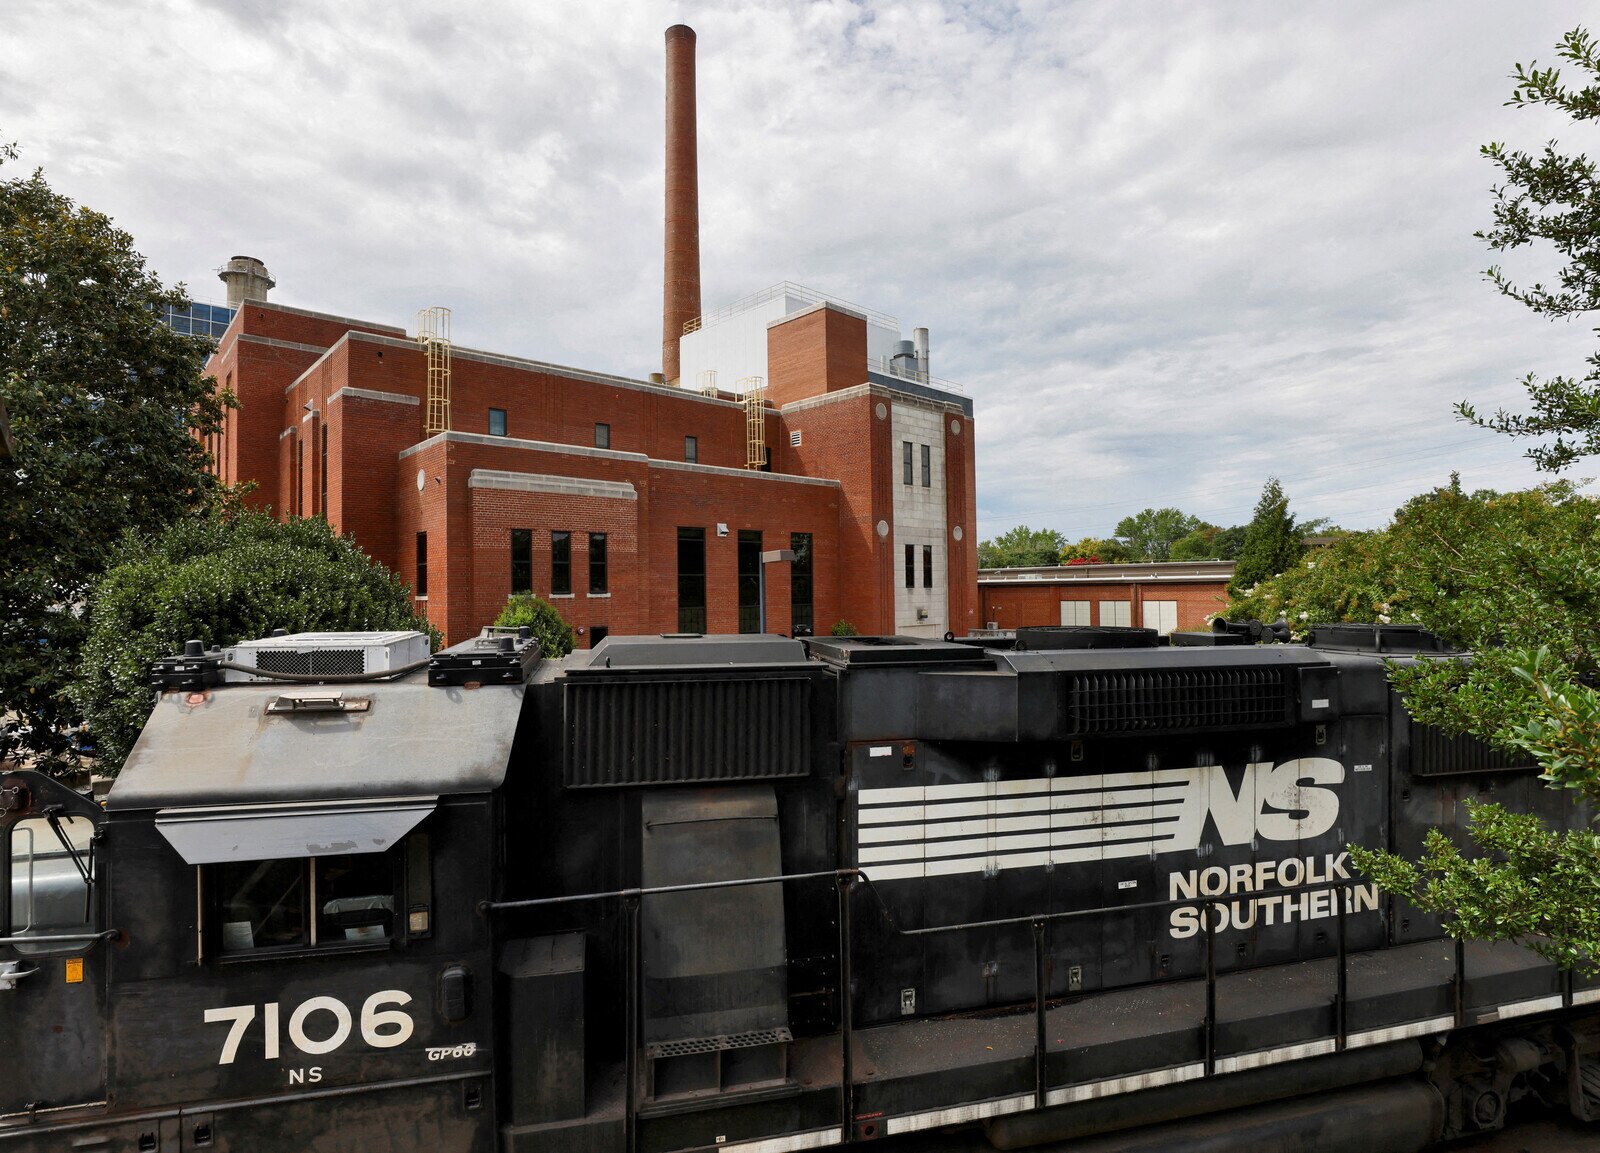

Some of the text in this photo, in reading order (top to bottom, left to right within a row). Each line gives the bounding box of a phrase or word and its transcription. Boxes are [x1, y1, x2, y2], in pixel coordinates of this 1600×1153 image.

[1174, 757, 1345, 850] NS
[1169, 852, 1351, 901] NORFOLK
[1169, 883, 1379, 939] SOUTHERN
[204, 990, 414, 1064] 7106
[289, 1067, 323, 1085] NS
